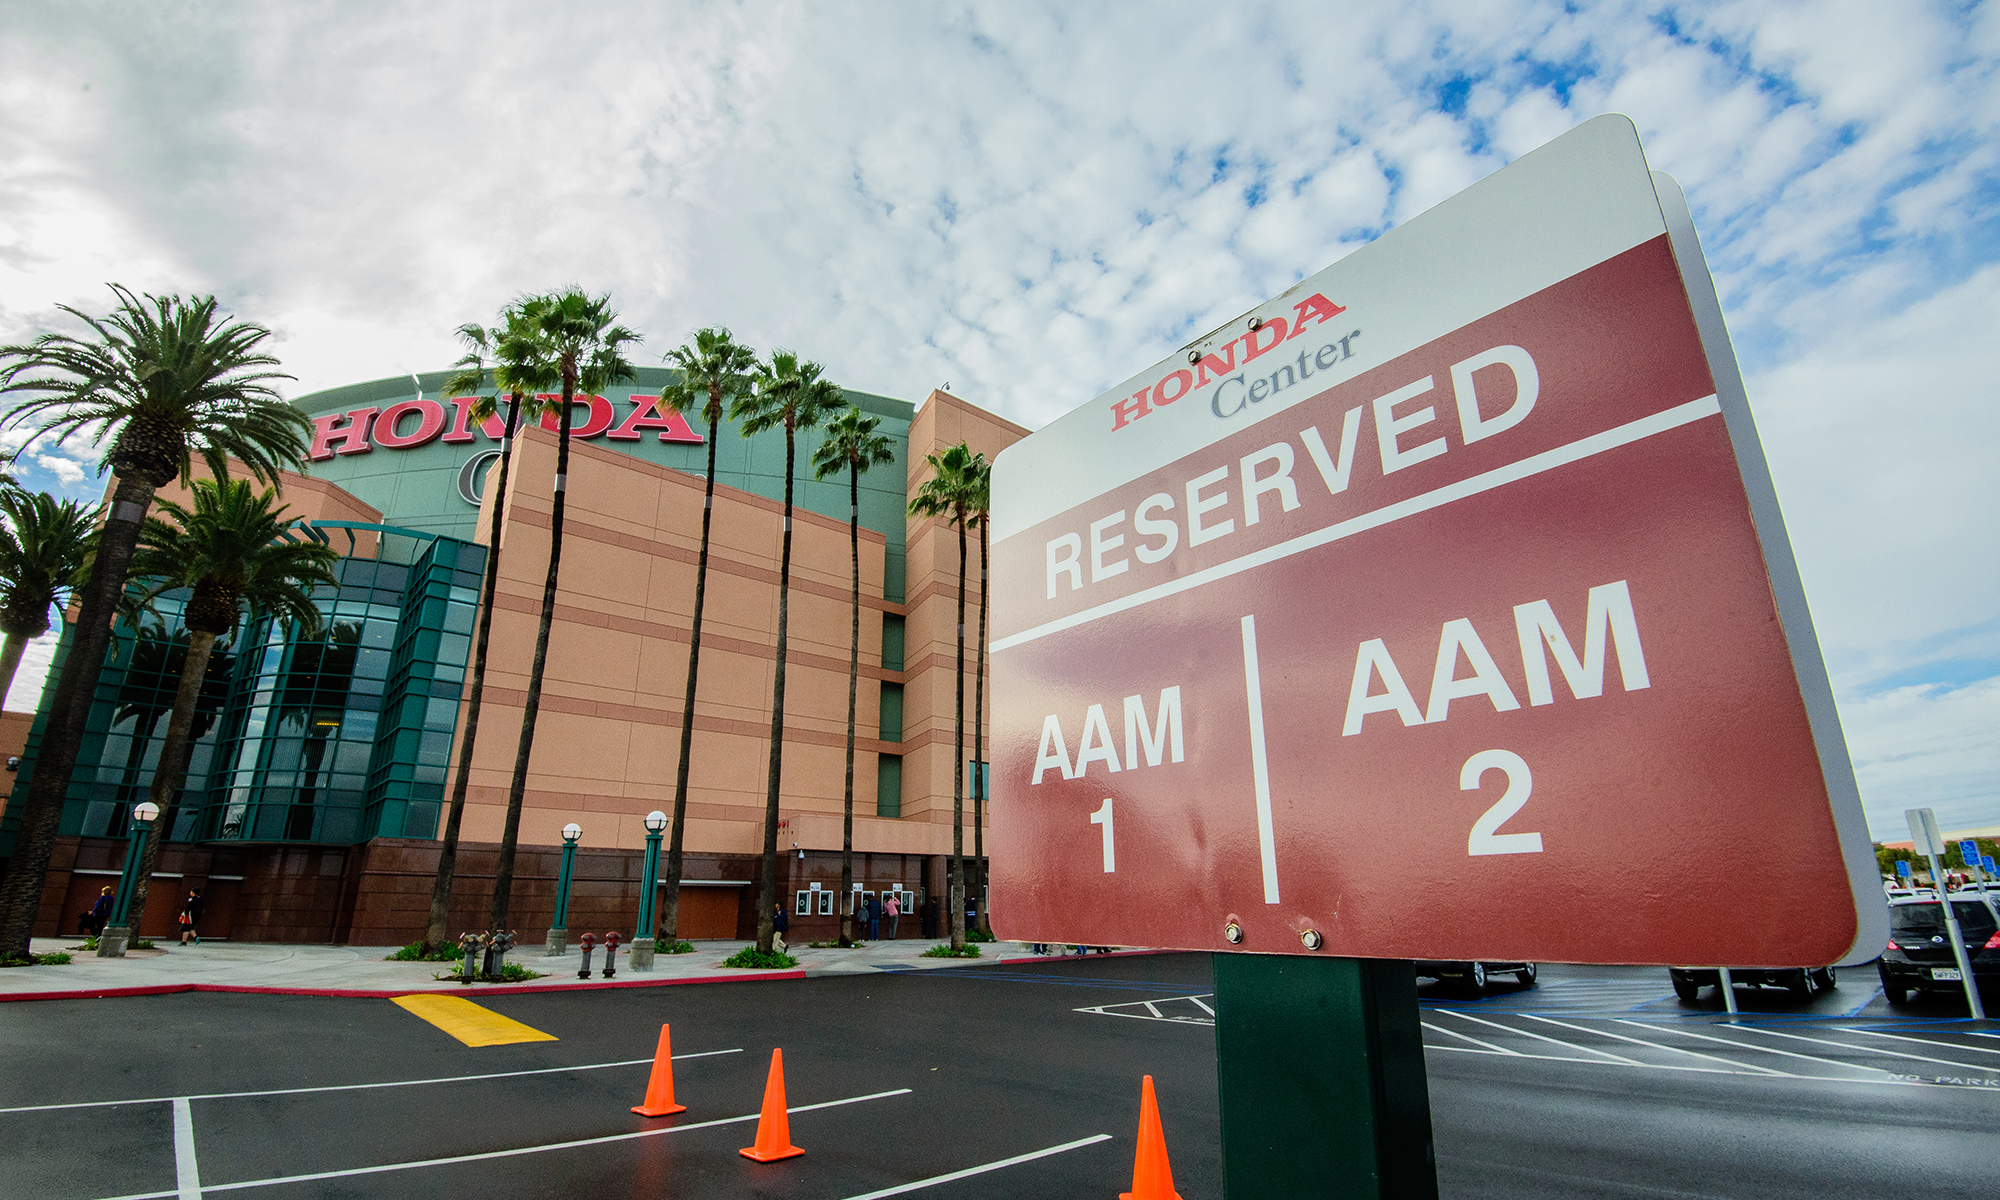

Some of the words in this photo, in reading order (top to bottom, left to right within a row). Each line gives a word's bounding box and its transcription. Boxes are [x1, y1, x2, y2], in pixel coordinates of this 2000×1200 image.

[1111, 293, 1347, 433] HONDA
[1211, 328, 1362, 419] Center
[1046, 344, 1540, 600] RESERVED
[1341, 579, 1651, 737] AAM
[1031, 685, 1184, 785] AAM
[1090, 798, 1116, 873] 1
[1459, 749, 1544, 856] 2
